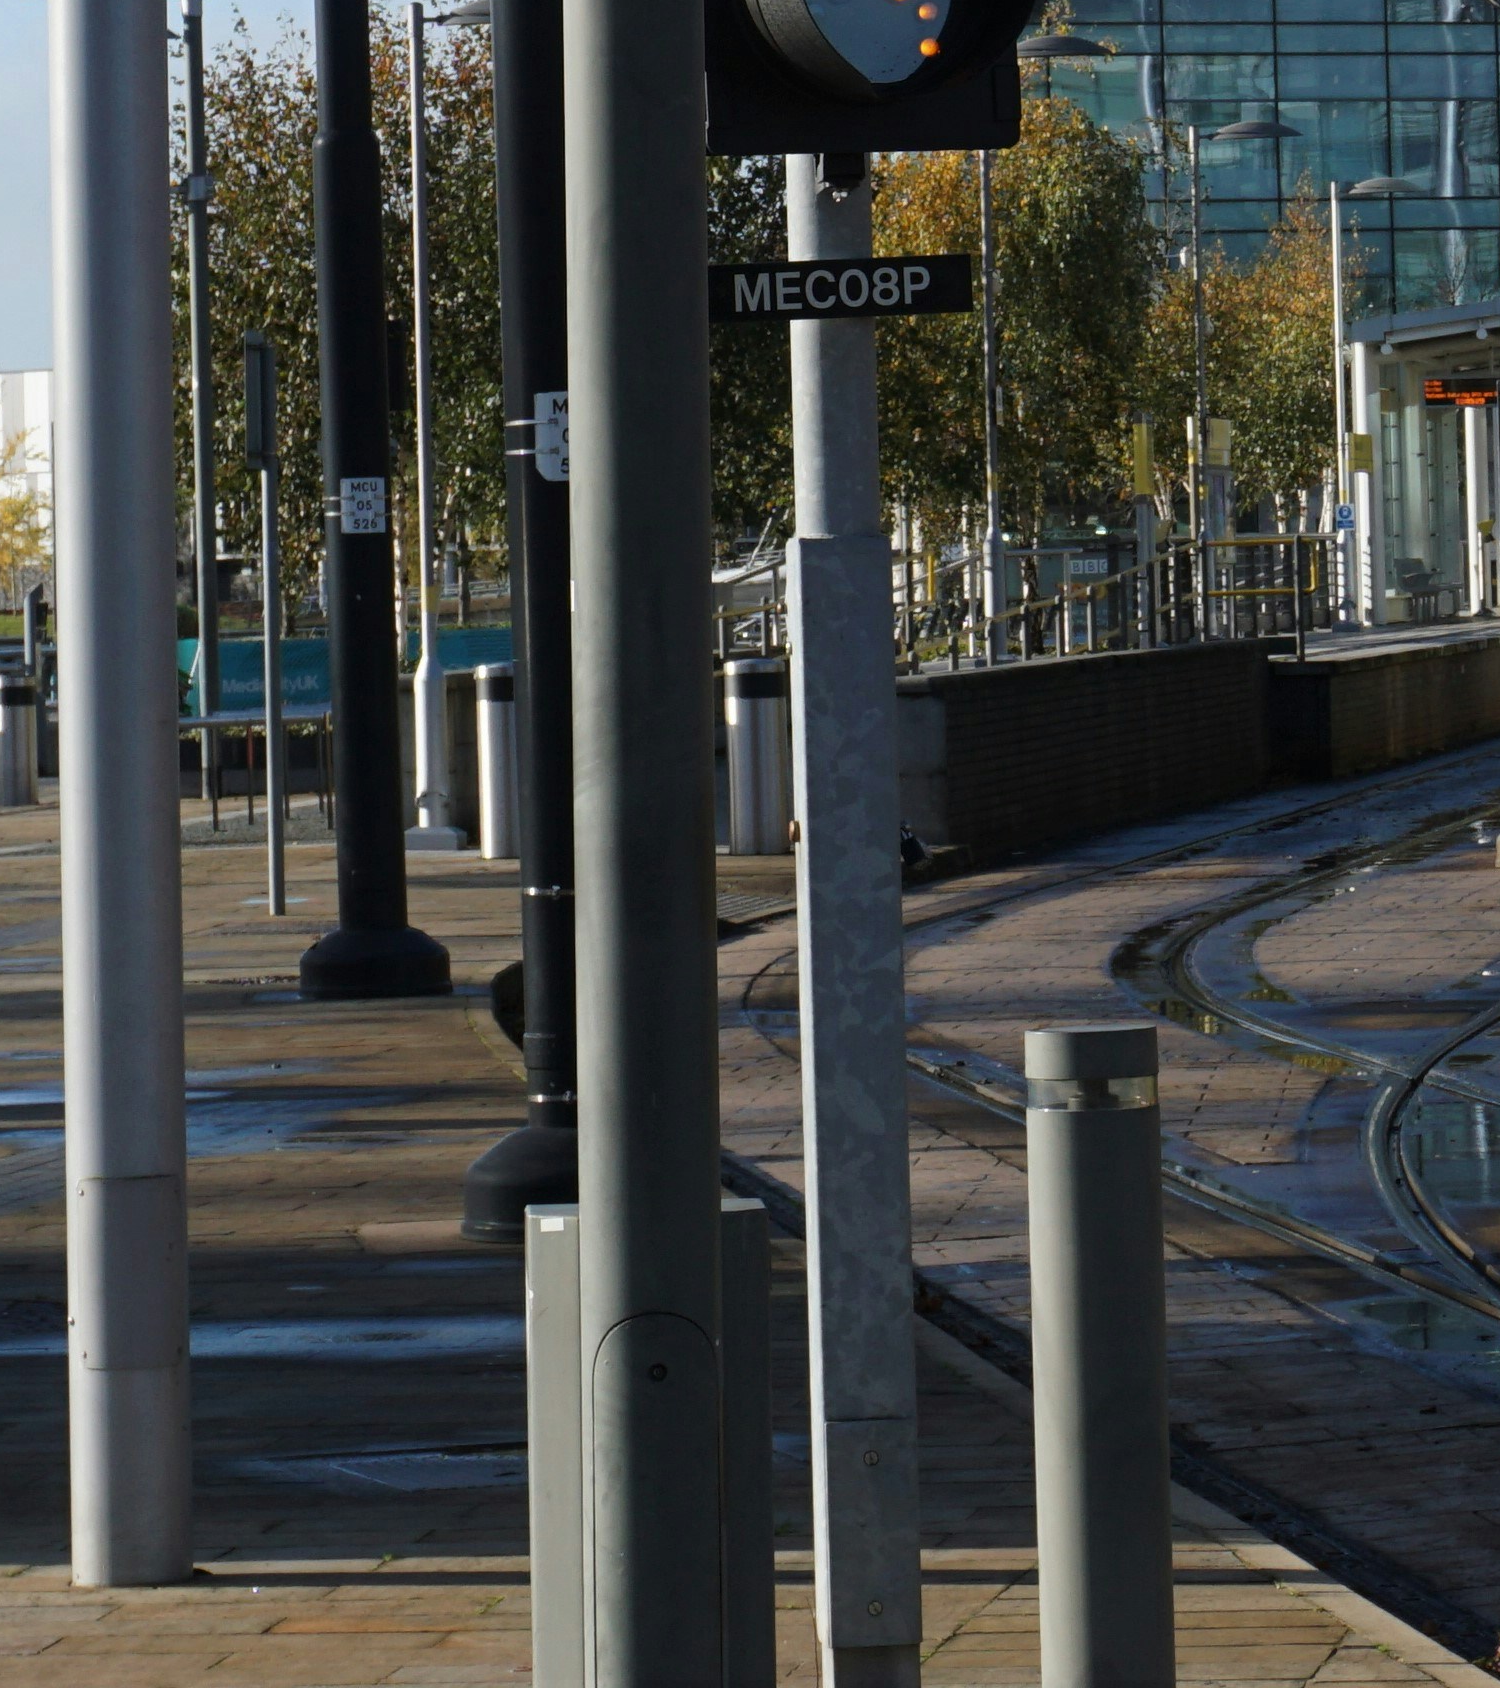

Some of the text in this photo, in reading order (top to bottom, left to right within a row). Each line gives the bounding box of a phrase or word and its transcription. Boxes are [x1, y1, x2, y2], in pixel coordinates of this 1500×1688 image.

[350, 481, 378, 492] MCU
[356, 500, 373, 511] 05
[353, 518, 378, 529] 526
